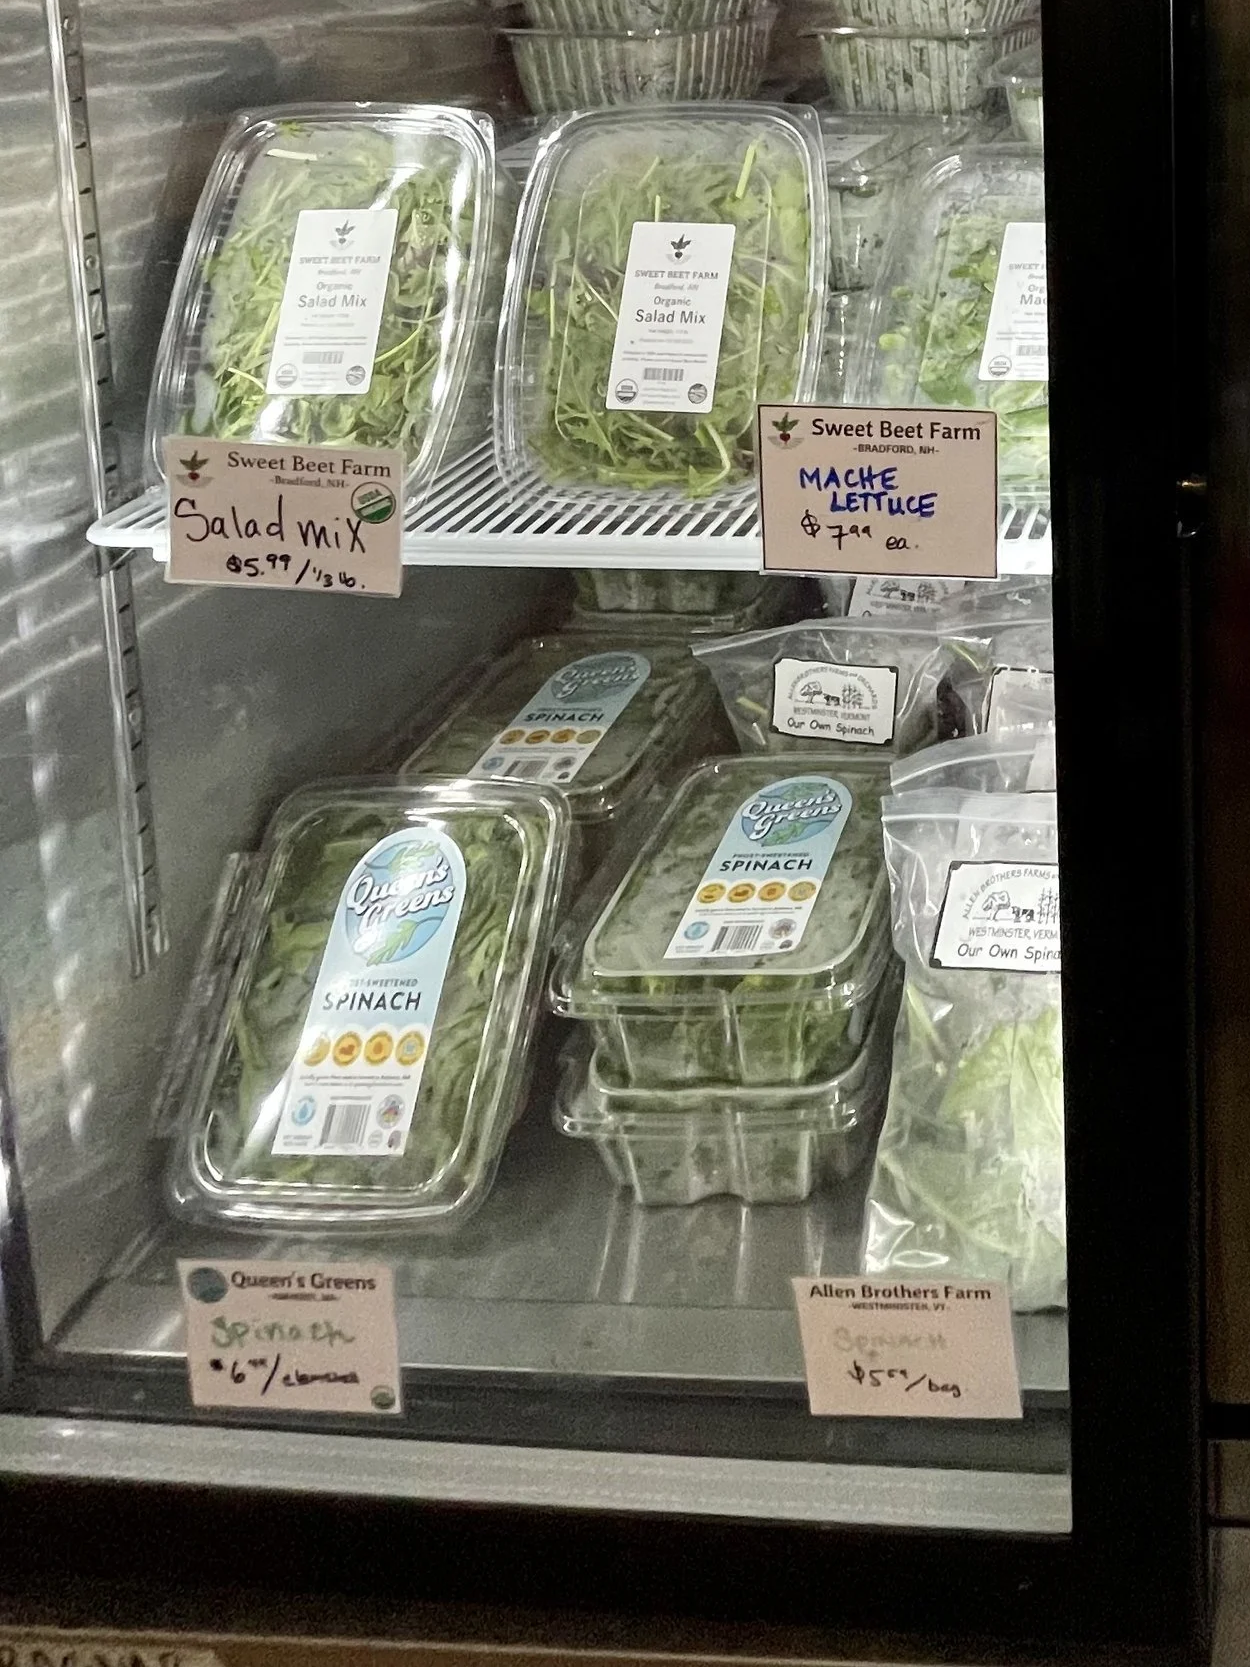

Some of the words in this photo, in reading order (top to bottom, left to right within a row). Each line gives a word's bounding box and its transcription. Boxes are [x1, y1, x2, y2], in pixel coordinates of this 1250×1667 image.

[635, 270, 665, 278] SWEET
[667, 271, 690, 279] BEET
[693, 271, 719, 280] FARM
[316, 282, 353, 292] Organic
[298, 295, 337, 308] Salad
[341, 295, 368, 307] Mix
[653, 296, 691, 307] Organic
[635, 309, 675, 323] Salad
[680, 311, 706, 324] Mix
[812, 418, 874, 437] Sweet
[880, 420, 924, 439] Beet
[930, 422, 981, 440] Farm
[227, 451, 286, 471] Sweet
[293, 455, 335, 473] Beet
[340, 459, 391, 478] Farm
[800, 465, 899, 491] MACHE
[830, 491, 938, 518] LETTUCE
[174, 494, 285, 543] Salad
[886, 536, 919, 550] ea.
[524, 713, 605, 722] SPINACH
[787, 718, 805, 728] Our
[809, 719, 831, 730] Own
[836, 723, 875, 736] Spinach
[742, 789, 837, 820] Queen's
[749, 803, 842, 840] Greens
[719, 859, 813, 872] SPINACH
[1024, 868, 1050, 879] FARMS
[352, 885, 455, 954] Greens
[957, 943, 983, 956] Our
[989, 944, 1018, 958] Own
[322, 990, 422, 1012] SPINACH
[231, 1270, 306, 1288] Queen's
[310, 1272, 377, 1291] Greens
[809, 1284, 856, 1299] Allen
[861, 1285, 939, 1300] Brothers
[944, 1286, 991, 1300] Farm
